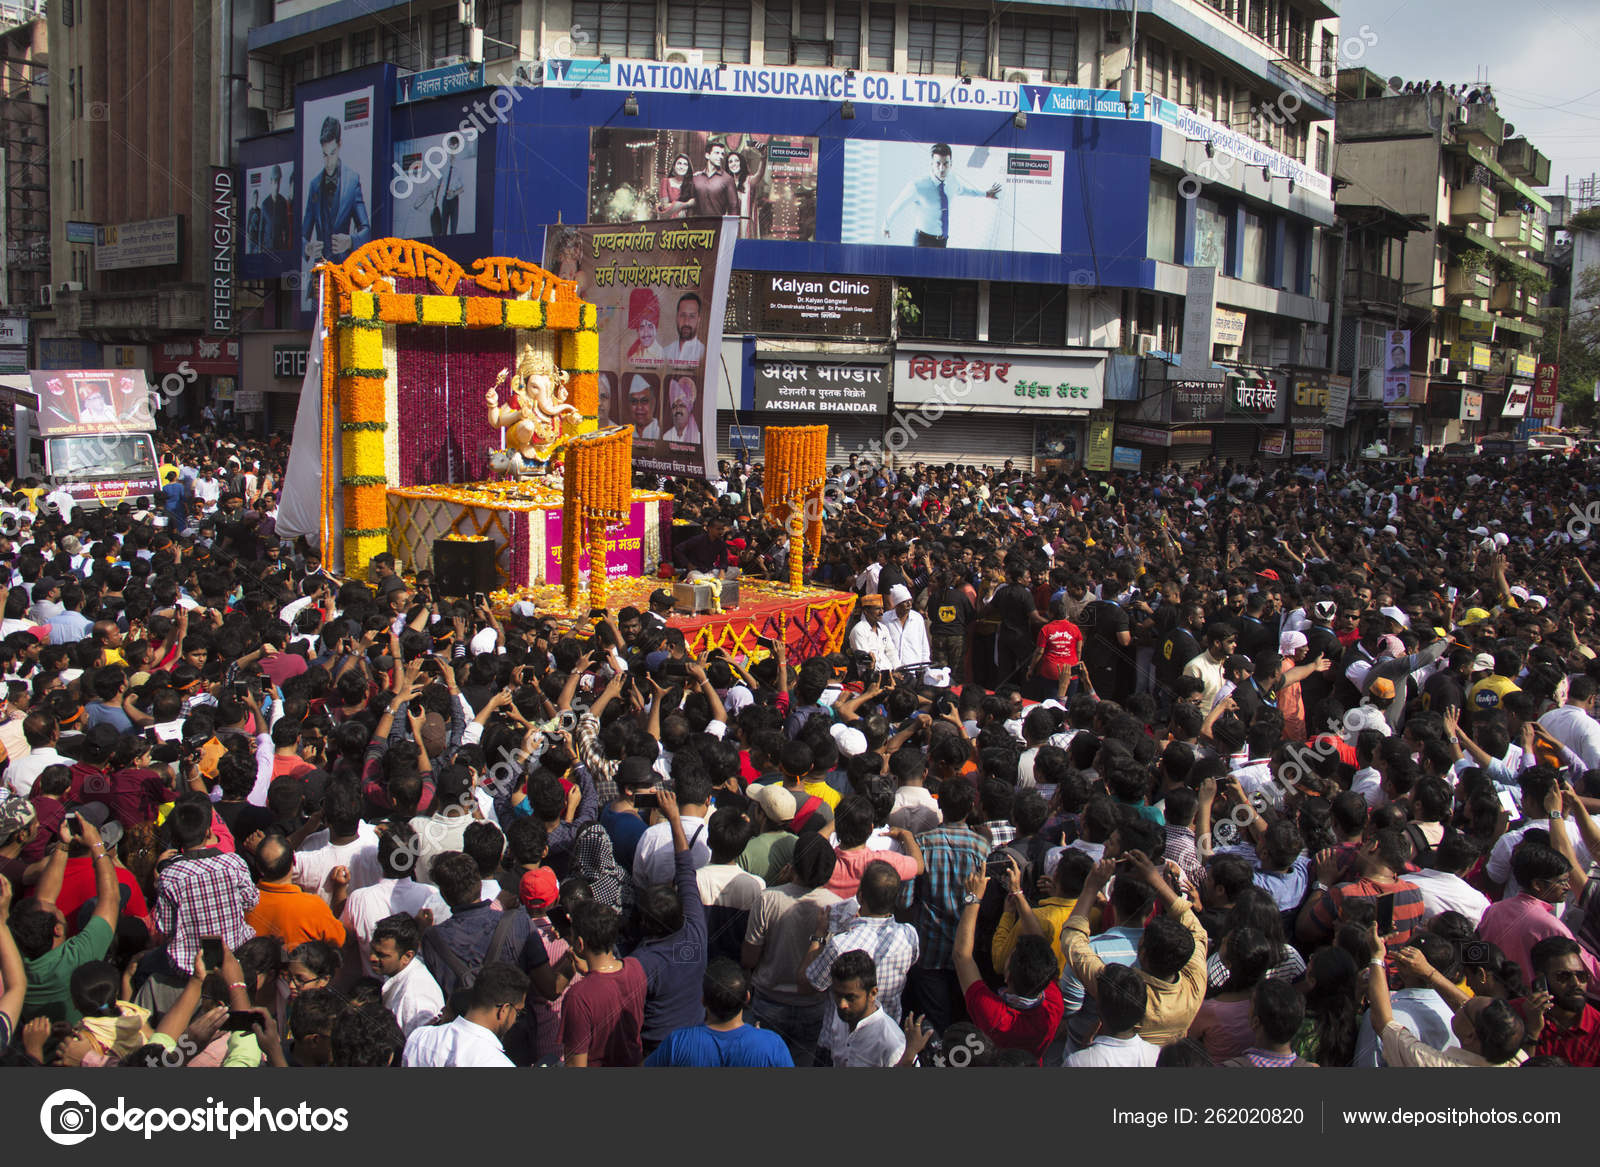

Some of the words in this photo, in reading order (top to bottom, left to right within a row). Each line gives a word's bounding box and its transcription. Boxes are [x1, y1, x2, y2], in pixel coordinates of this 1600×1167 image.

[617, 63, 726, 91] NATIONAL
[733, 69, 856, 99] INSURANCE
[862, 76, 895, 100] CO.
[1052, 93, 1092, 112] National
[214, 172, 231, 273] ENGLAND
[592, 224, 656, 259] पुण्यनगरीत
[659, 222, 716, 250] आलेल्या
[595, 259, 617, 287] सर्व
[618, 257, 702, 287] गणेशभक्तांचे
[772, 278, 823, 295] Kalyan
[829, 280, 869, 295] Clinic
[214, 277, 231, 330] PETER
[274, 350, 310, 375] PETE
[762, 363, 808, 382] अक्षर
[816, 364, 884, 384] भाण्डार
[779, 385, 807, 397] स्टेशनरी
[818, 388, 842, 399] पुस्तक
[1236, 380, 1256, 408] पीटर
[765, 400, 815, 410] AKSHAR
[819, 401, 878, 412] BHANDAR
[617, 533, 641, 551] मंडळ
